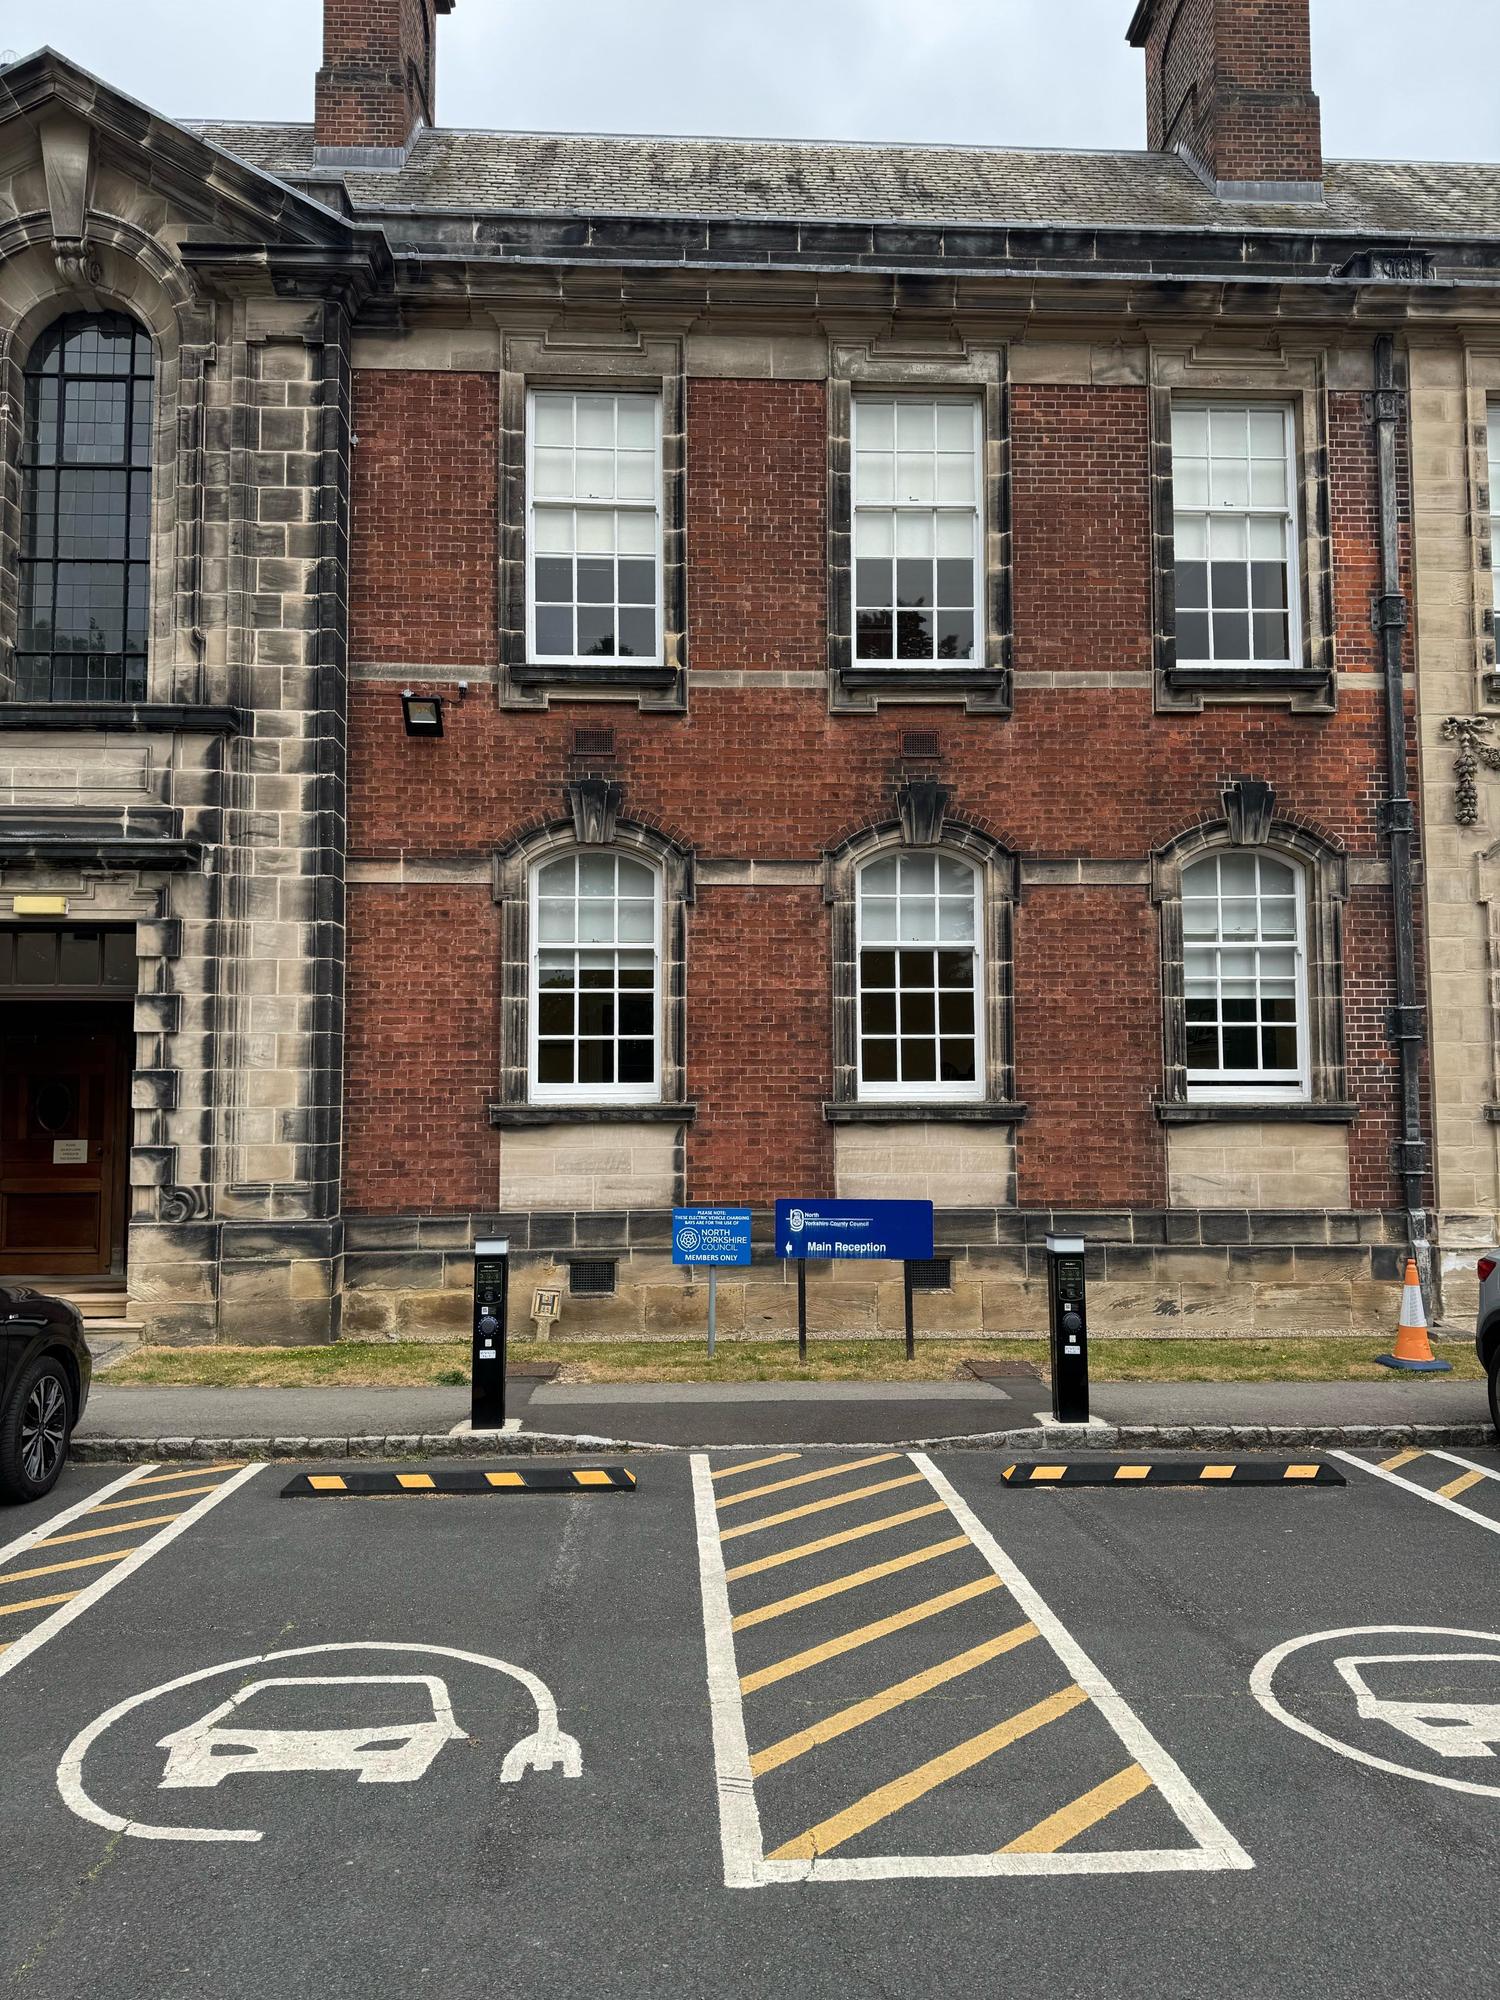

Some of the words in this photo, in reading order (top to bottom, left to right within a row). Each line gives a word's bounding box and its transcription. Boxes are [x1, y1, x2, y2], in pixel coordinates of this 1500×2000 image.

[829, 1220, 849, 1228] County
[701, 1236, 748, 1244] YORKSHIRE
[701, 1243, 738, 1251] COUNCIL
[807, 1241, 832, 1252] Main
[834, 1241, 887, 1253] Reception
